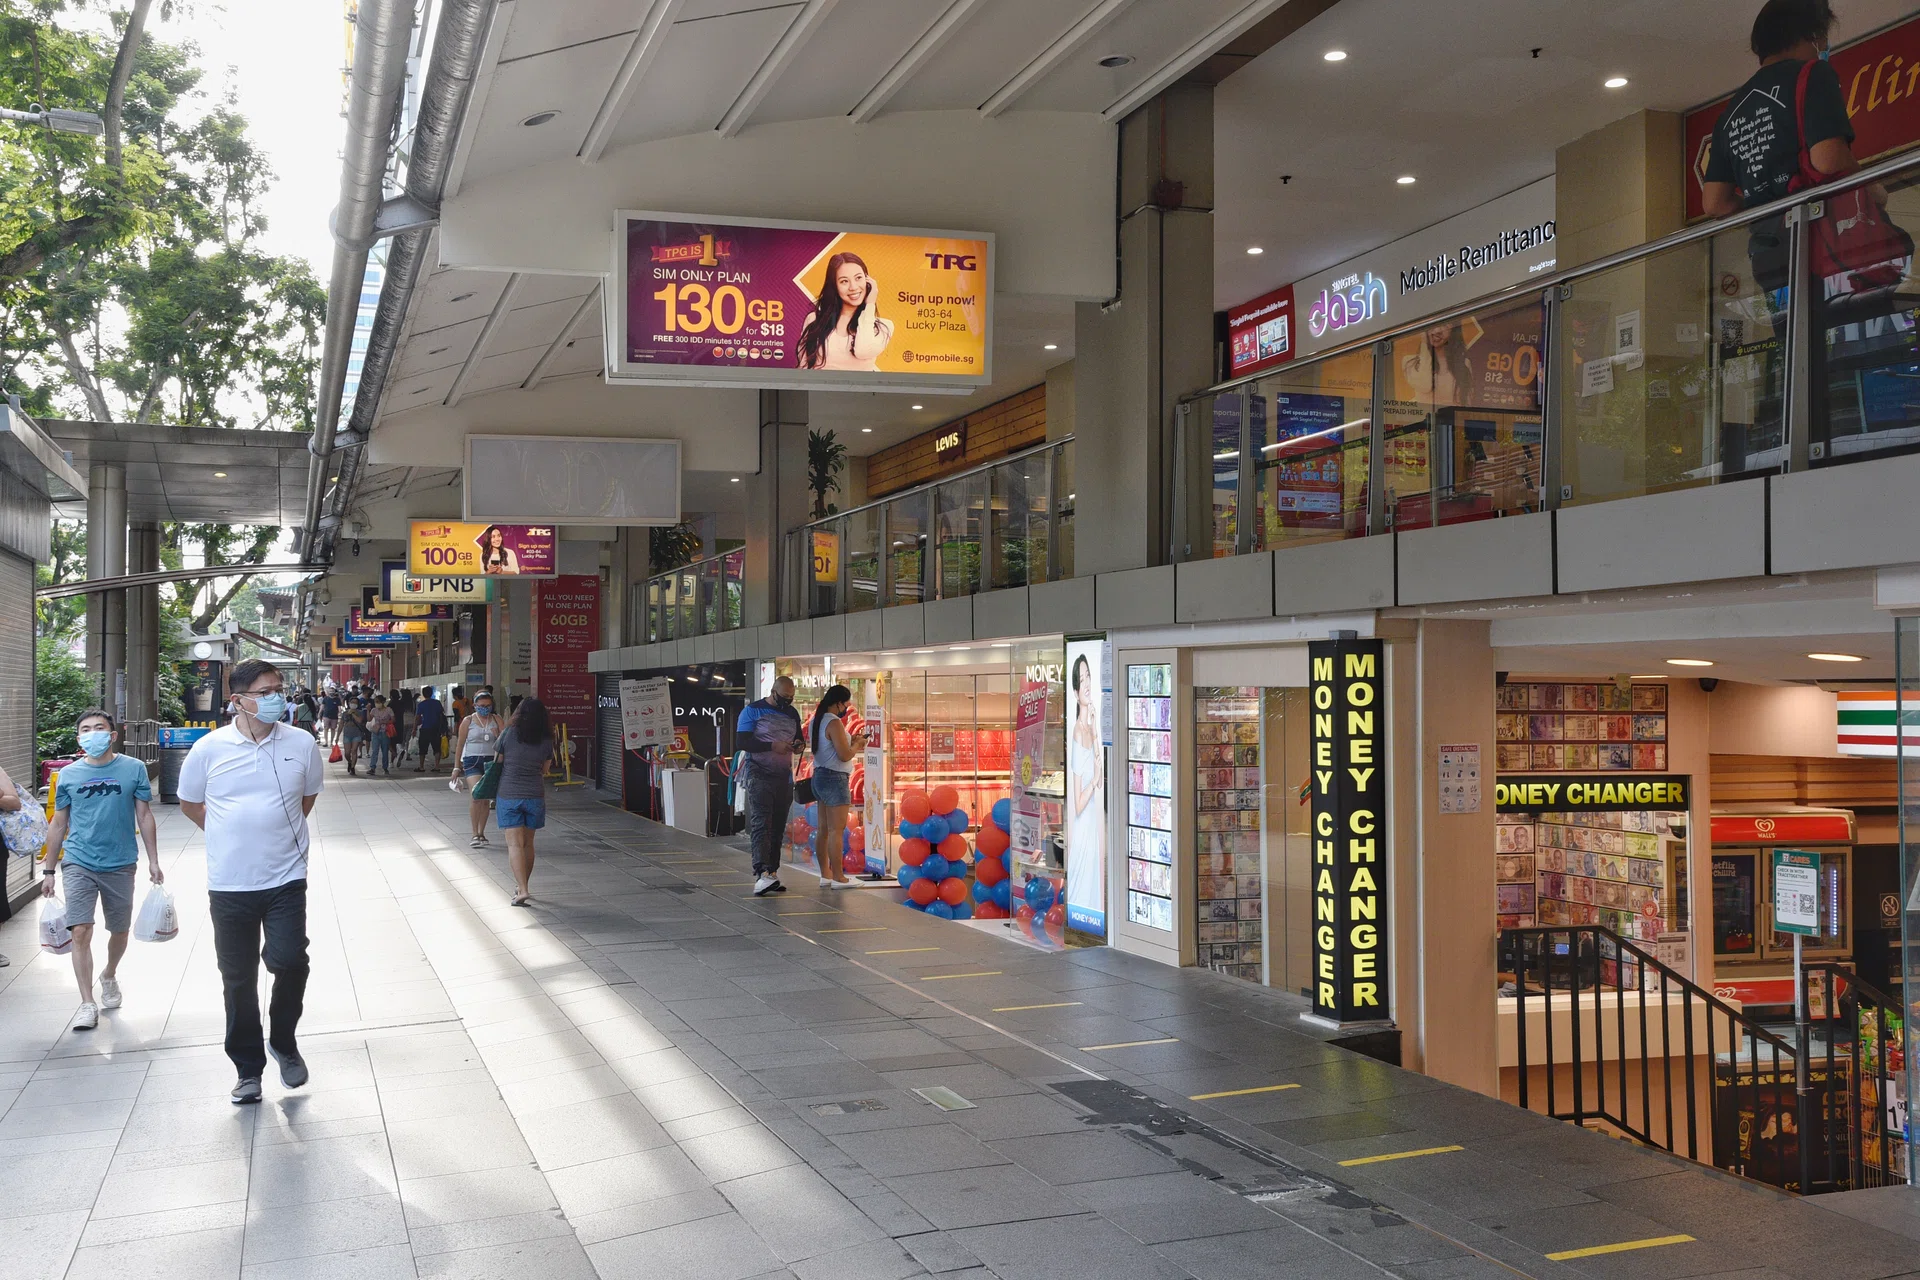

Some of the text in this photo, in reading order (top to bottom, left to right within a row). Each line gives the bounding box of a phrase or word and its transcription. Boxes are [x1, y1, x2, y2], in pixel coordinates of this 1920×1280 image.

[665, 234, 718, 267] TPG IS 1
[1400, 220, 1556, 295] Mobile Remittanc
[925, 252, 976, 271] TPG
[653, 268, 750, 284] SIM ONLY PLAN
[898, 292, 975, 306] Sign up now!
[1308, 272, 1387, 338] dash
[654, 283, 784, 334] 130 GB
[917, 308, 952, 319] #03-64
[746, 322, 785, 336] for $18
[906, 320, 966, 332] Lucky Plaza
[653, 335, 784, 347] FREE 300 IDD minutes to 21 countries
[916, 353, 974, 365] tpgmobile.sg
[529, 528, 551, 536] TPG
[421, 547, 473, 566] 100 GB
[430, 579, 474, 593] PNB
[550, 614, 588, 626] 60GB
[545, 633, 565, 645] $35
[1026, 664, 1063, 683] MONEY
[1020, 686, 1046, 707] OPENING
[1024, 702, 1039, 718] SALE
[1496, 783, 1684, 806] ONEY CHANGER
[1313, 657, 1336, 1010] MONEY CHANGER
[1345, 653, 1379, 1008] MONEY CHANGER
